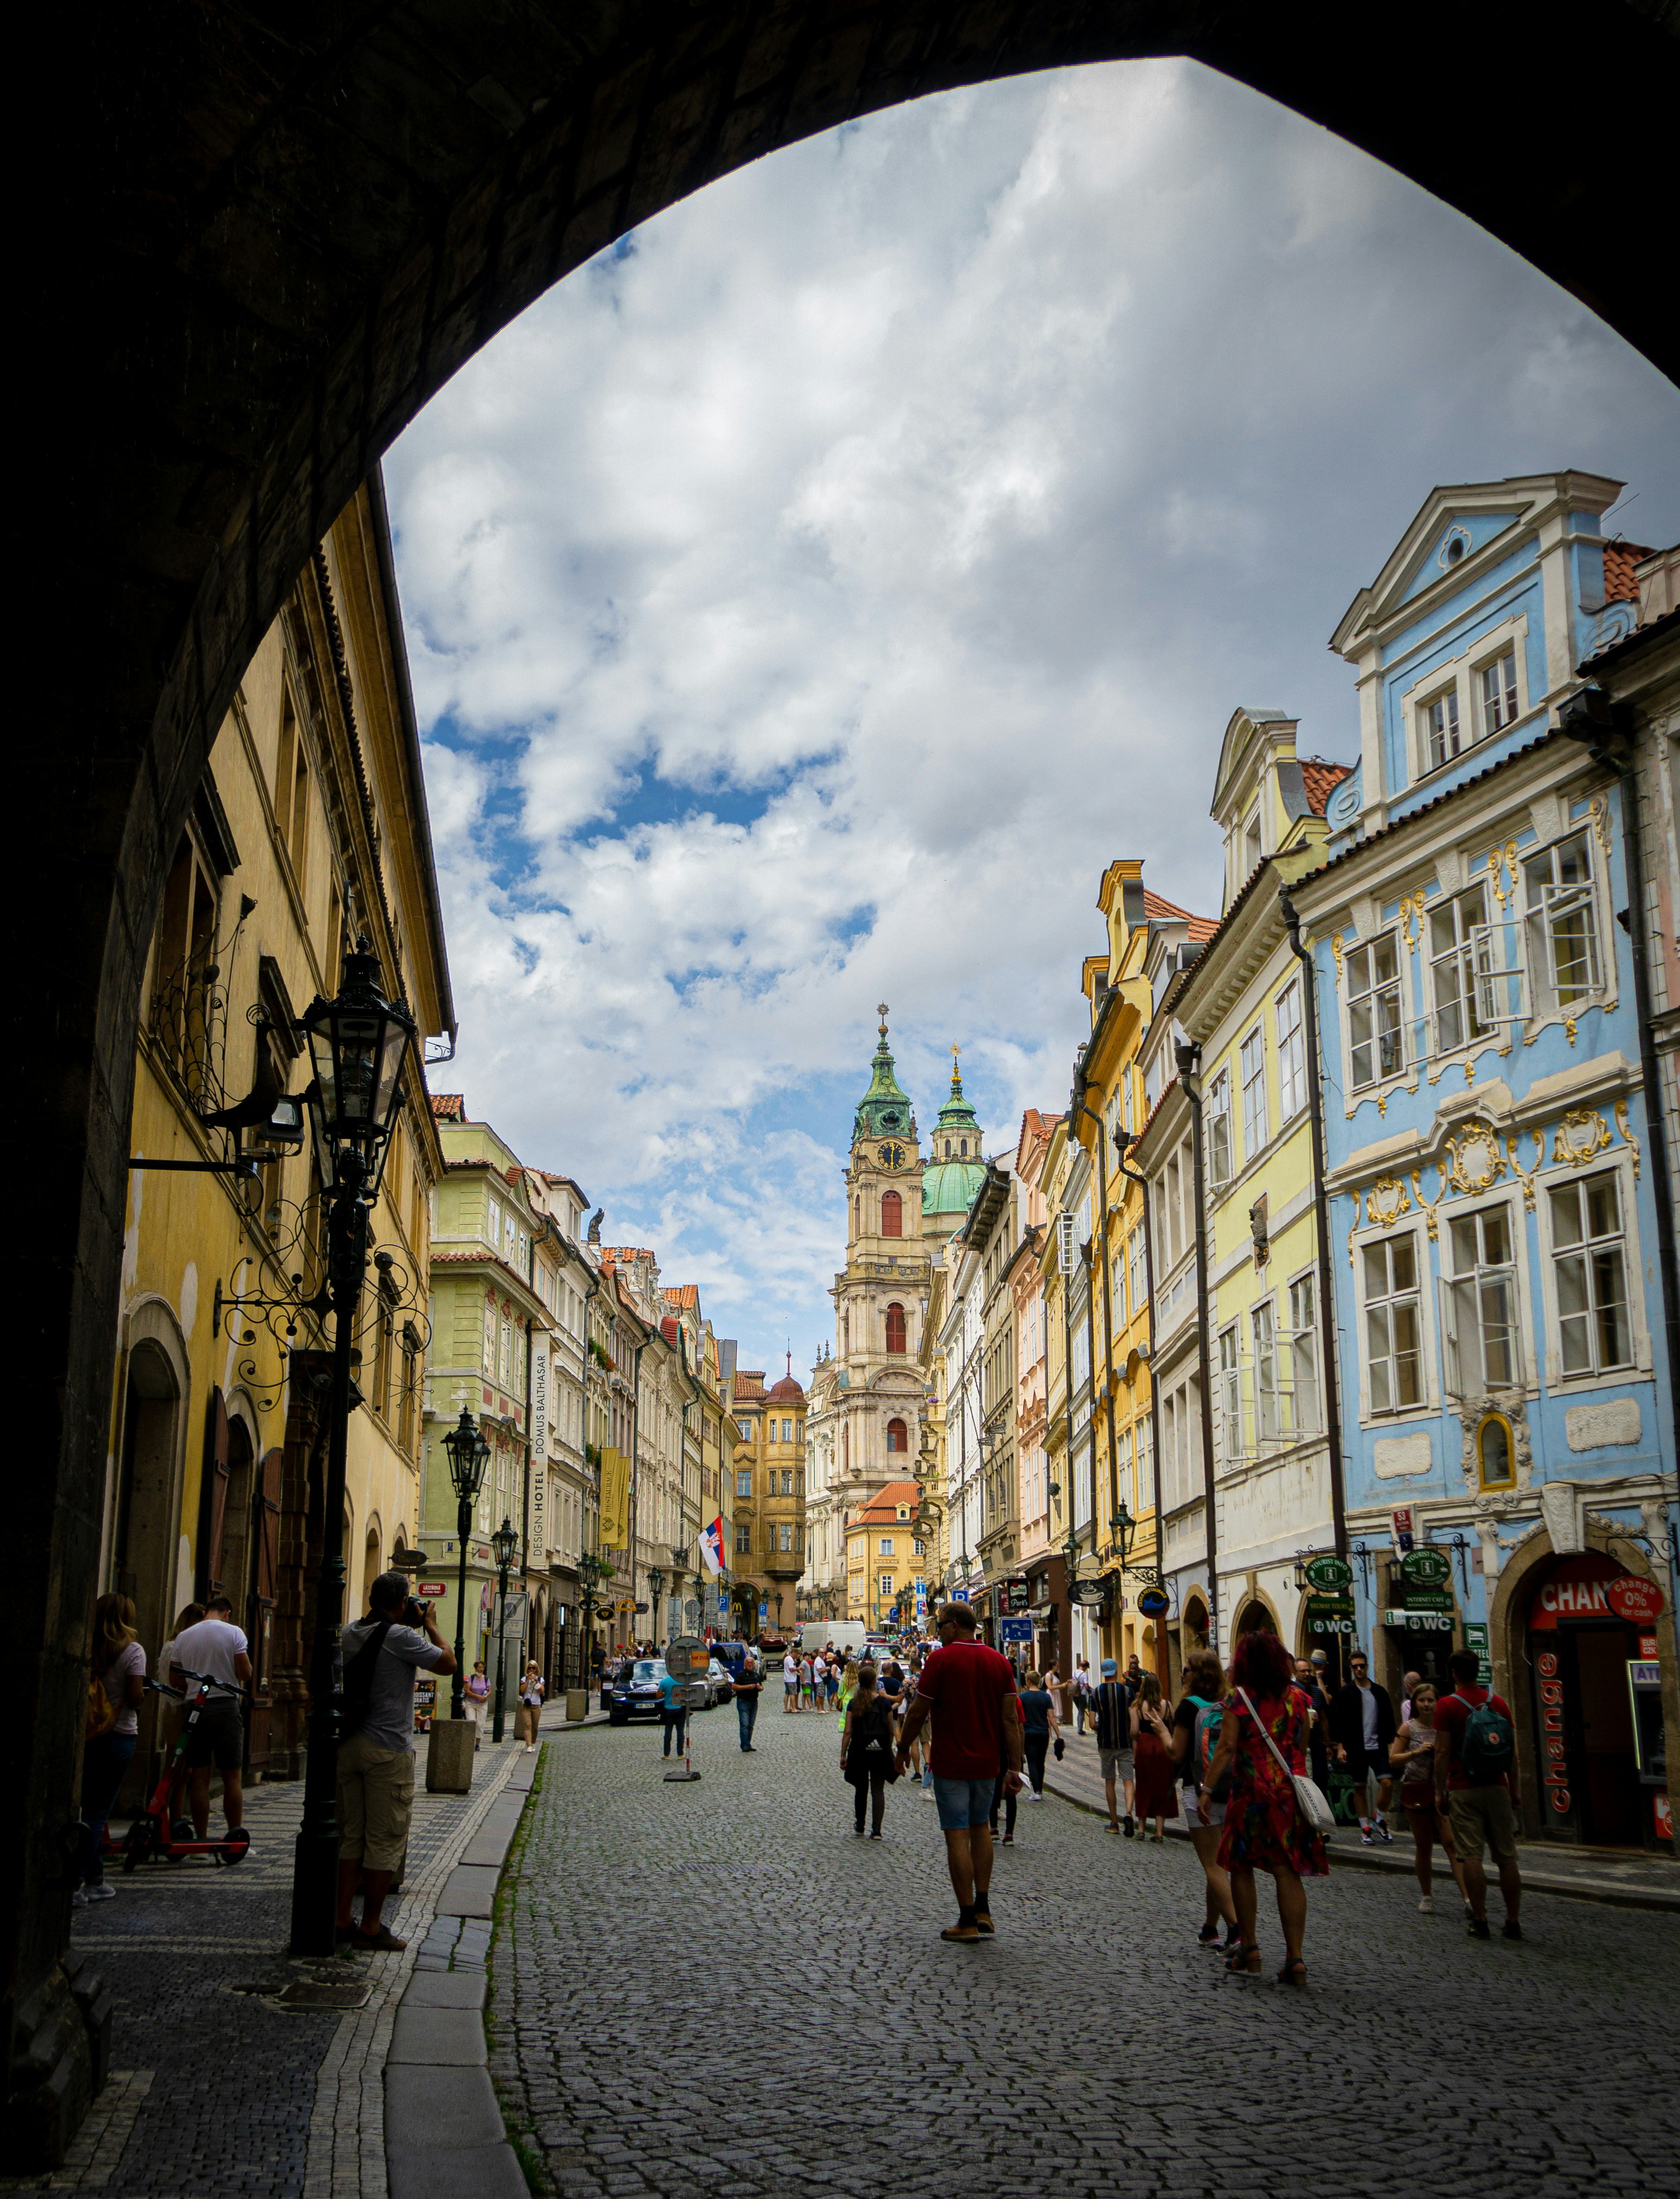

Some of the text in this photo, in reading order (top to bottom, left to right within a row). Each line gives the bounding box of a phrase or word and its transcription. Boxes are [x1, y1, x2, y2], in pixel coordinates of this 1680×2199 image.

[533, 1355, 546, 1556] DESIGN HOTEL DOMUS BALTHASAR
[1397, 1511, 1406, 1521] 53
[1406, 1551, 1445, 1563] TOURIST INFO
[1311, 1559, 1348, 1571] TOURIST INFO
[1143, 1587, 1168, 1599] RESTAURACE
[1614, 1579, 1656, 1595] change
[720, 1598, 725, 1606] P
[1624, 1591, 1647, 1607] 0%
[1620, 1607, 1653, 1617] for cash
[1326, 1620, 1353, 1633] WC
[1422, 1617, 1451, 1631] WC
[1538, 1653, 1571, 1813] change
